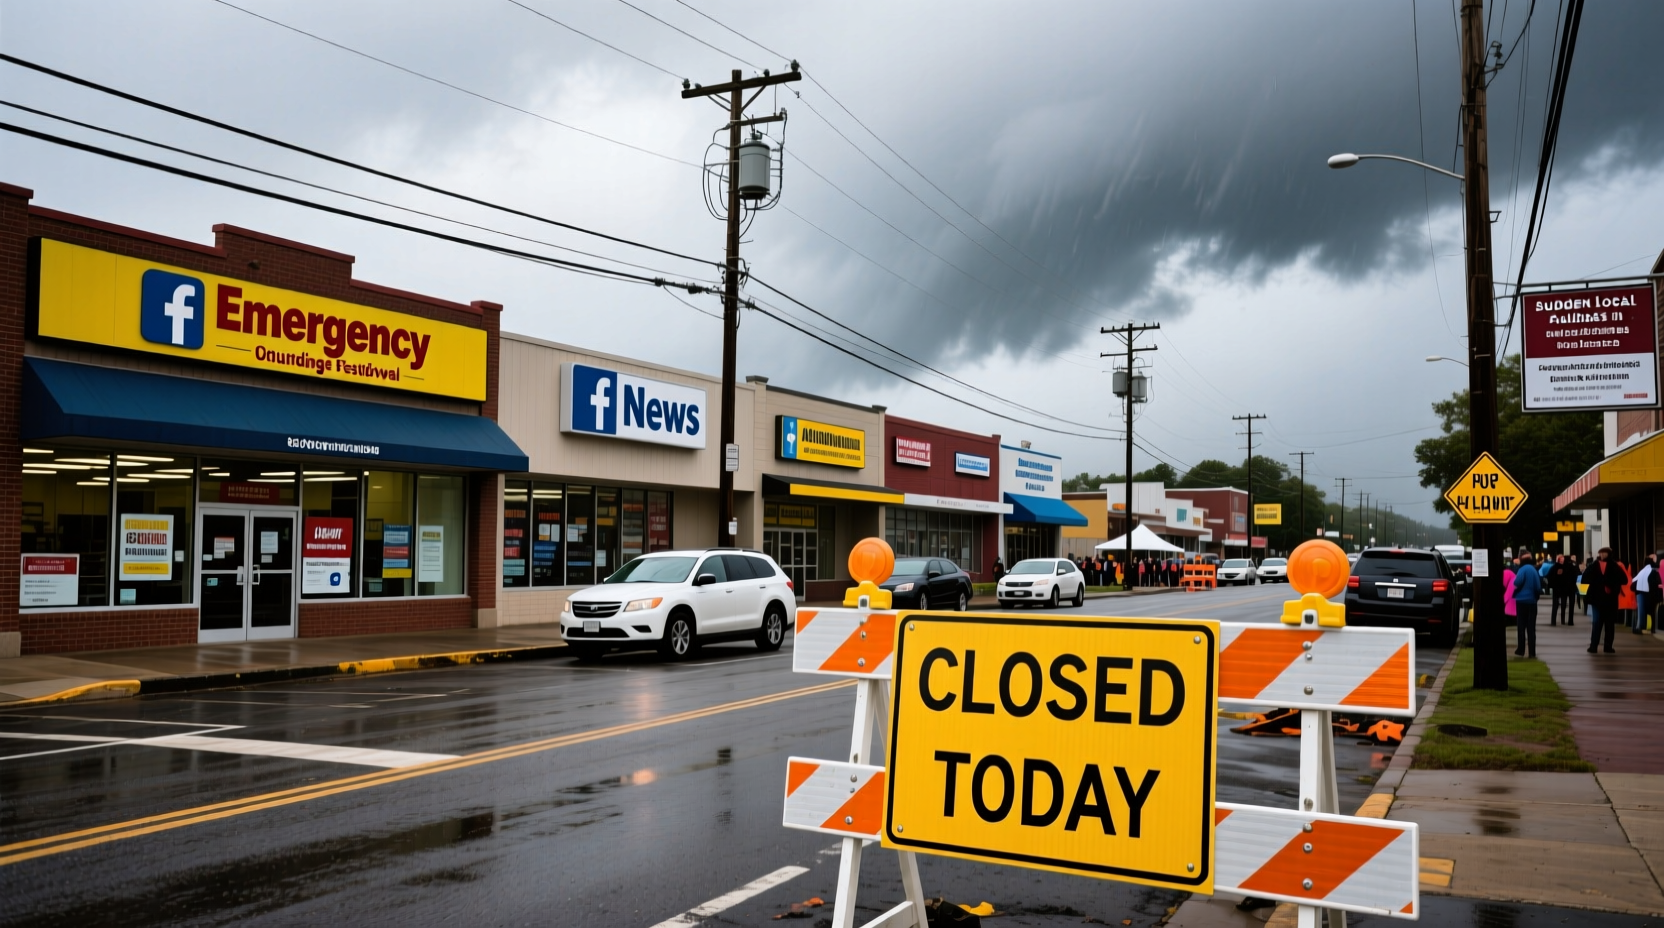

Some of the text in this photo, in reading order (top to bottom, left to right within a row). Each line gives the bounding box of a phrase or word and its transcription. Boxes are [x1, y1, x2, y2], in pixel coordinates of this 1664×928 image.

[216, 283, 430, 371] Emergency
[1535, 298, 1591, 312] SUDDEN
[623, 384, 700, 436] News
[918, 646, 1185, 727] CLOSED
[934, 749, 1160, 839] TODAY
